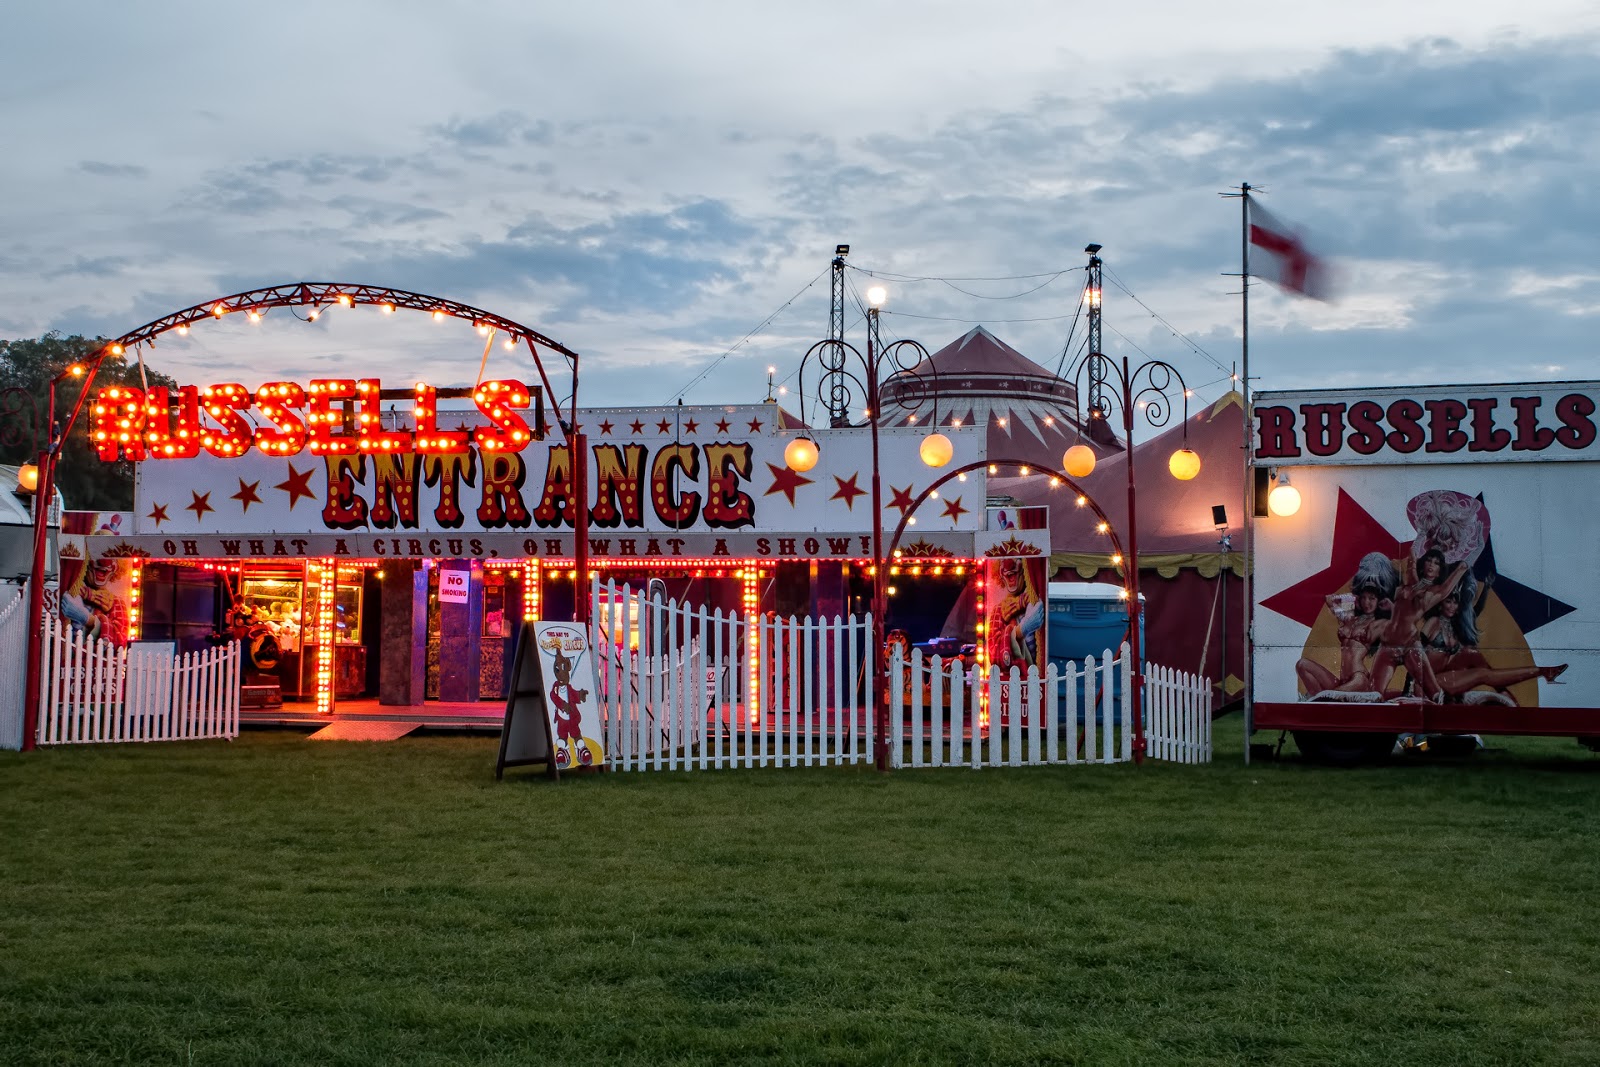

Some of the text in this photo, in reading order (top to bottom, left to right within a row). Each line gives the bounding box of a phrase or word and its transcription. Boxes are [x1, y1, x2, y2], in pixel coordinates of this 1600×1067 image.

[95, 378, 530, 462] RUSSELLS
[1254, 393, 1597, 458] RUSSELLS
[322, 443, 755, 529] ENTRANCE
[163, 536, 871, 558] OH WHAT A CIRCUS, OH WHAT A SHOW!
[442, 589, 466, 597] SMOKING
[447, 577, 463, 586] NO
